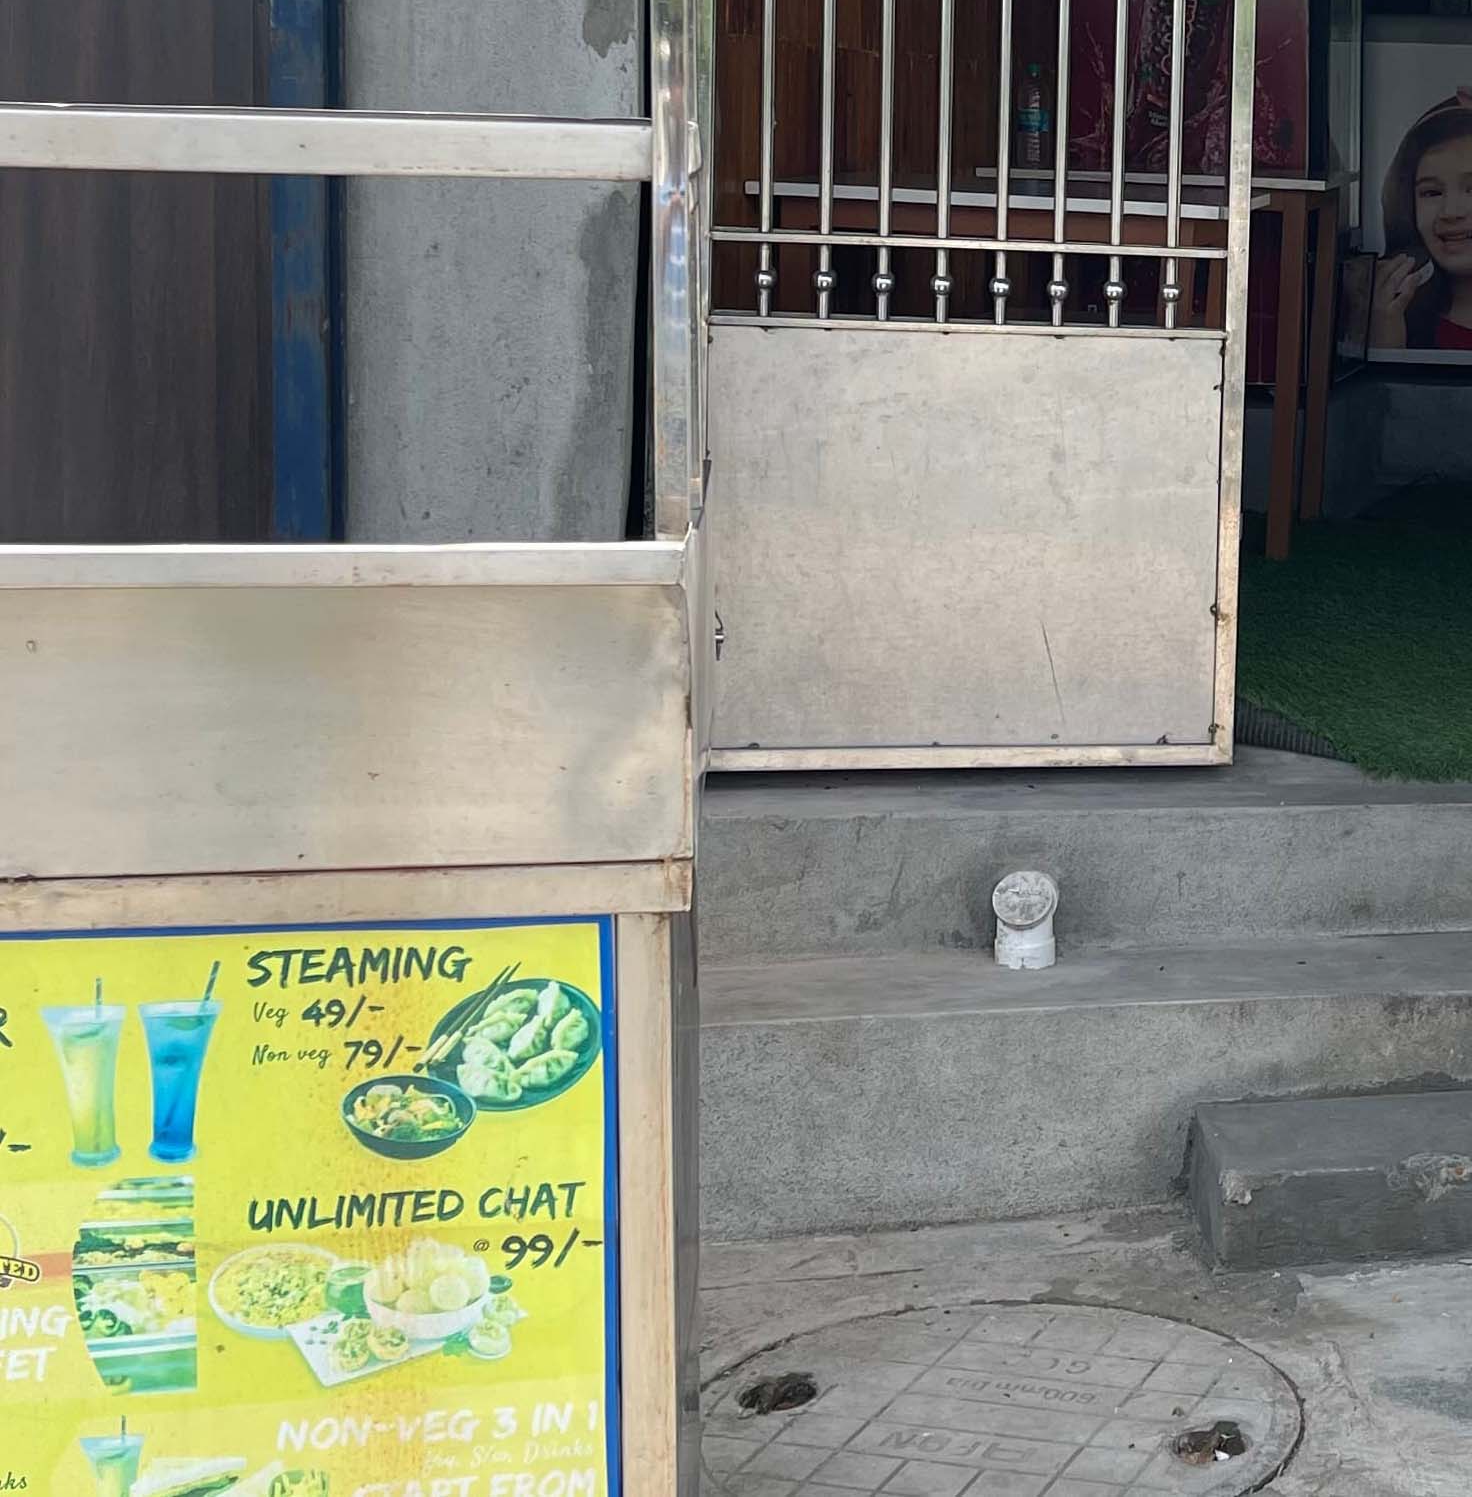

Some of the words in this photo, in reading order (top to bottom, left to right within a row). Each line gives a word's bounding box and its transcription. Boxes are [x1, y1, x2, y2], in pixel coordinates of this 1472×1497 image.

[247, 946, 473, 989] STEAMING
[253, 1001, 289, 1028] Veg
[301, 994, 386, 1028] 49/-
[251, 1044, 291, 1066] Non
[297, 1047, 332, 1069] veg
[343, 1034, 422, 1071] 79/-
[248, 1188, 465, 1233] UNLIMITED
[478, 1181, 586, 1220] CHAT
[0, 1259, 38, 1280] TED
[500, 1227, 604, 1270] 99/-
[276, 1408, 480, 1451] NON-VEG
[492, 1406, 518, 1440] 3
[531, 1402, 574, 1438] IN
